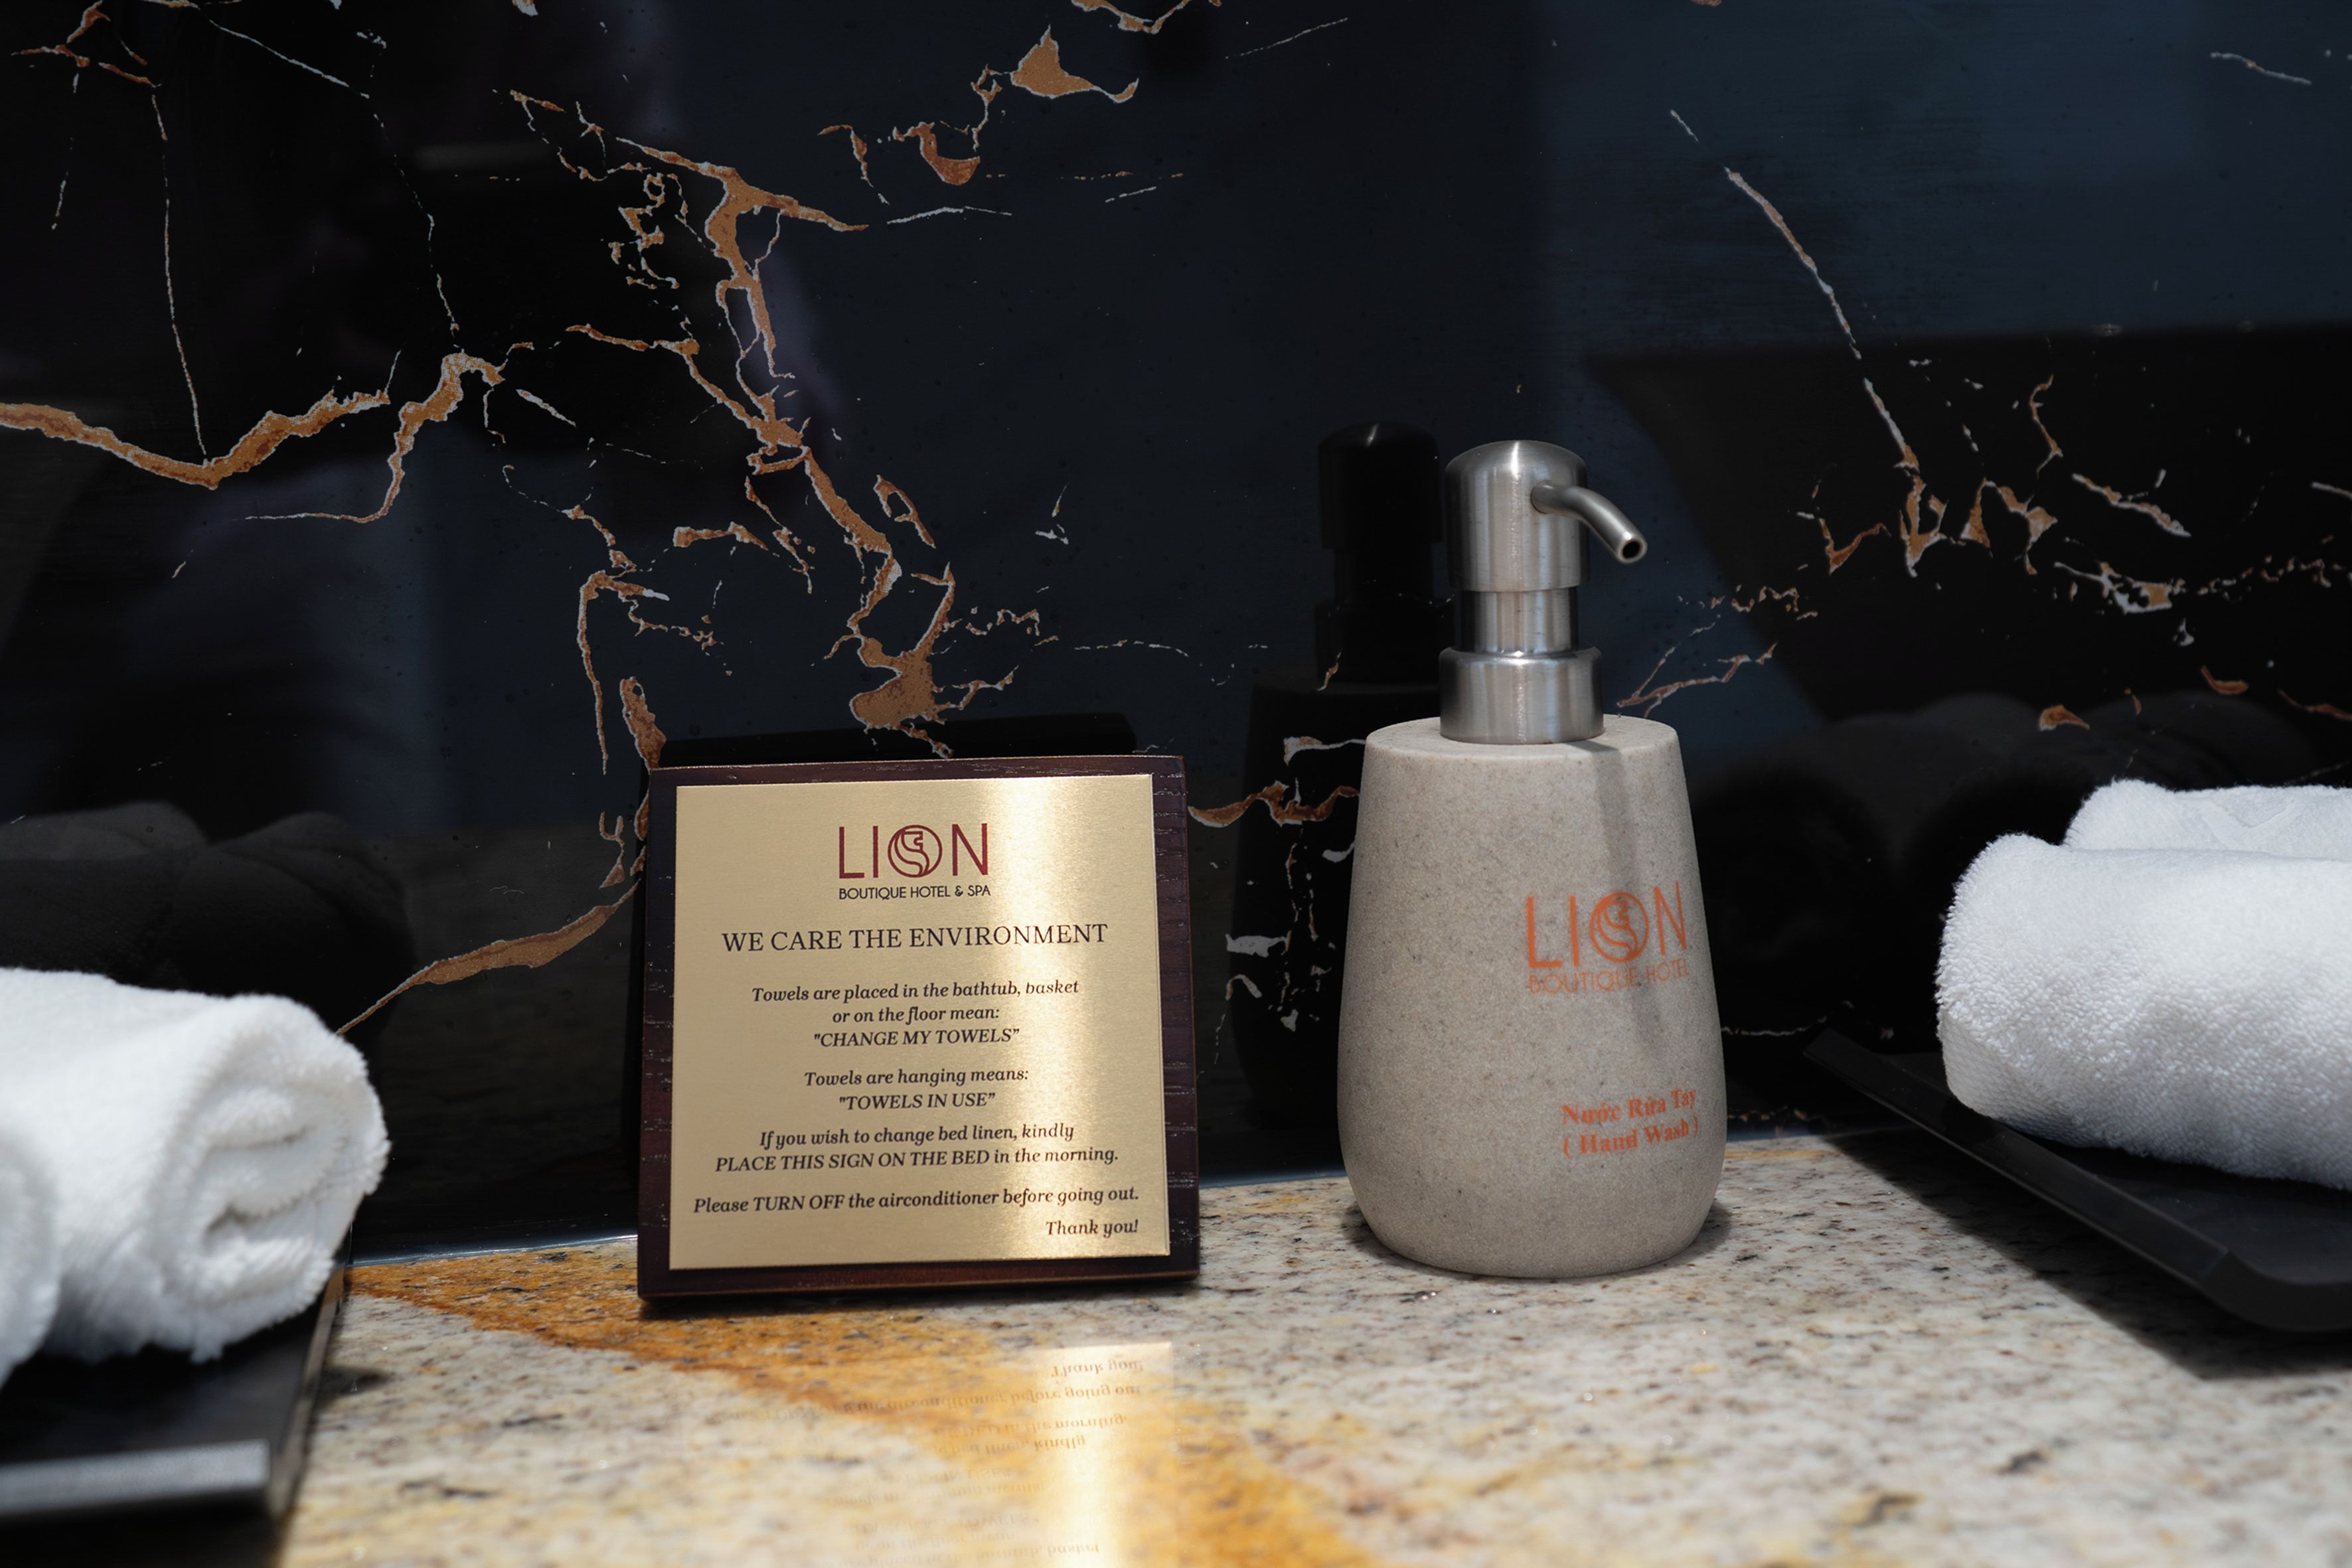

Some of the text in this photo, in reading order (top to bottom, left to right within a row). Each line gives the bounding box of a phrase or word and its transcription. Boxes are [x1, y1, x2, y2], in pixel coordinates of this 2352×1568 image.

[838, 823, 988, 880] LION
[838, 884, 991, 901] BOUTIQUE HOTEL & SPA
[721, 923, 1109, 952] WE CARE THE ENVIRONMENT
[1527, 882, 1687, 968] LION
[1529, 959, 1689, 994] BOUTIQUE HOTEL
[751, 979, 1079, 1004] Towels are placed in the bathtub, basket
[832, 1006, 1000, 1026] or on the floor mean:
[902, 1030, 932, 1045] MY
[804, 1068, 1029, 1088] Towels are hanging means:
[927, 1093, 948, 1108] IN
[1671, 1088, 1696, 1109] Tay
[759, 1123, 1074, 1150] If you wish to change bed linen, kindly
[715, 1146, 1119, 1172] PLACE THIS SIGN ON THE BED in the morning.
[693, 1186, 1139, 1214] Please TURN OFF the airconditioner before going out.
[1046, 1219, 1138, 1239] Thank you!
